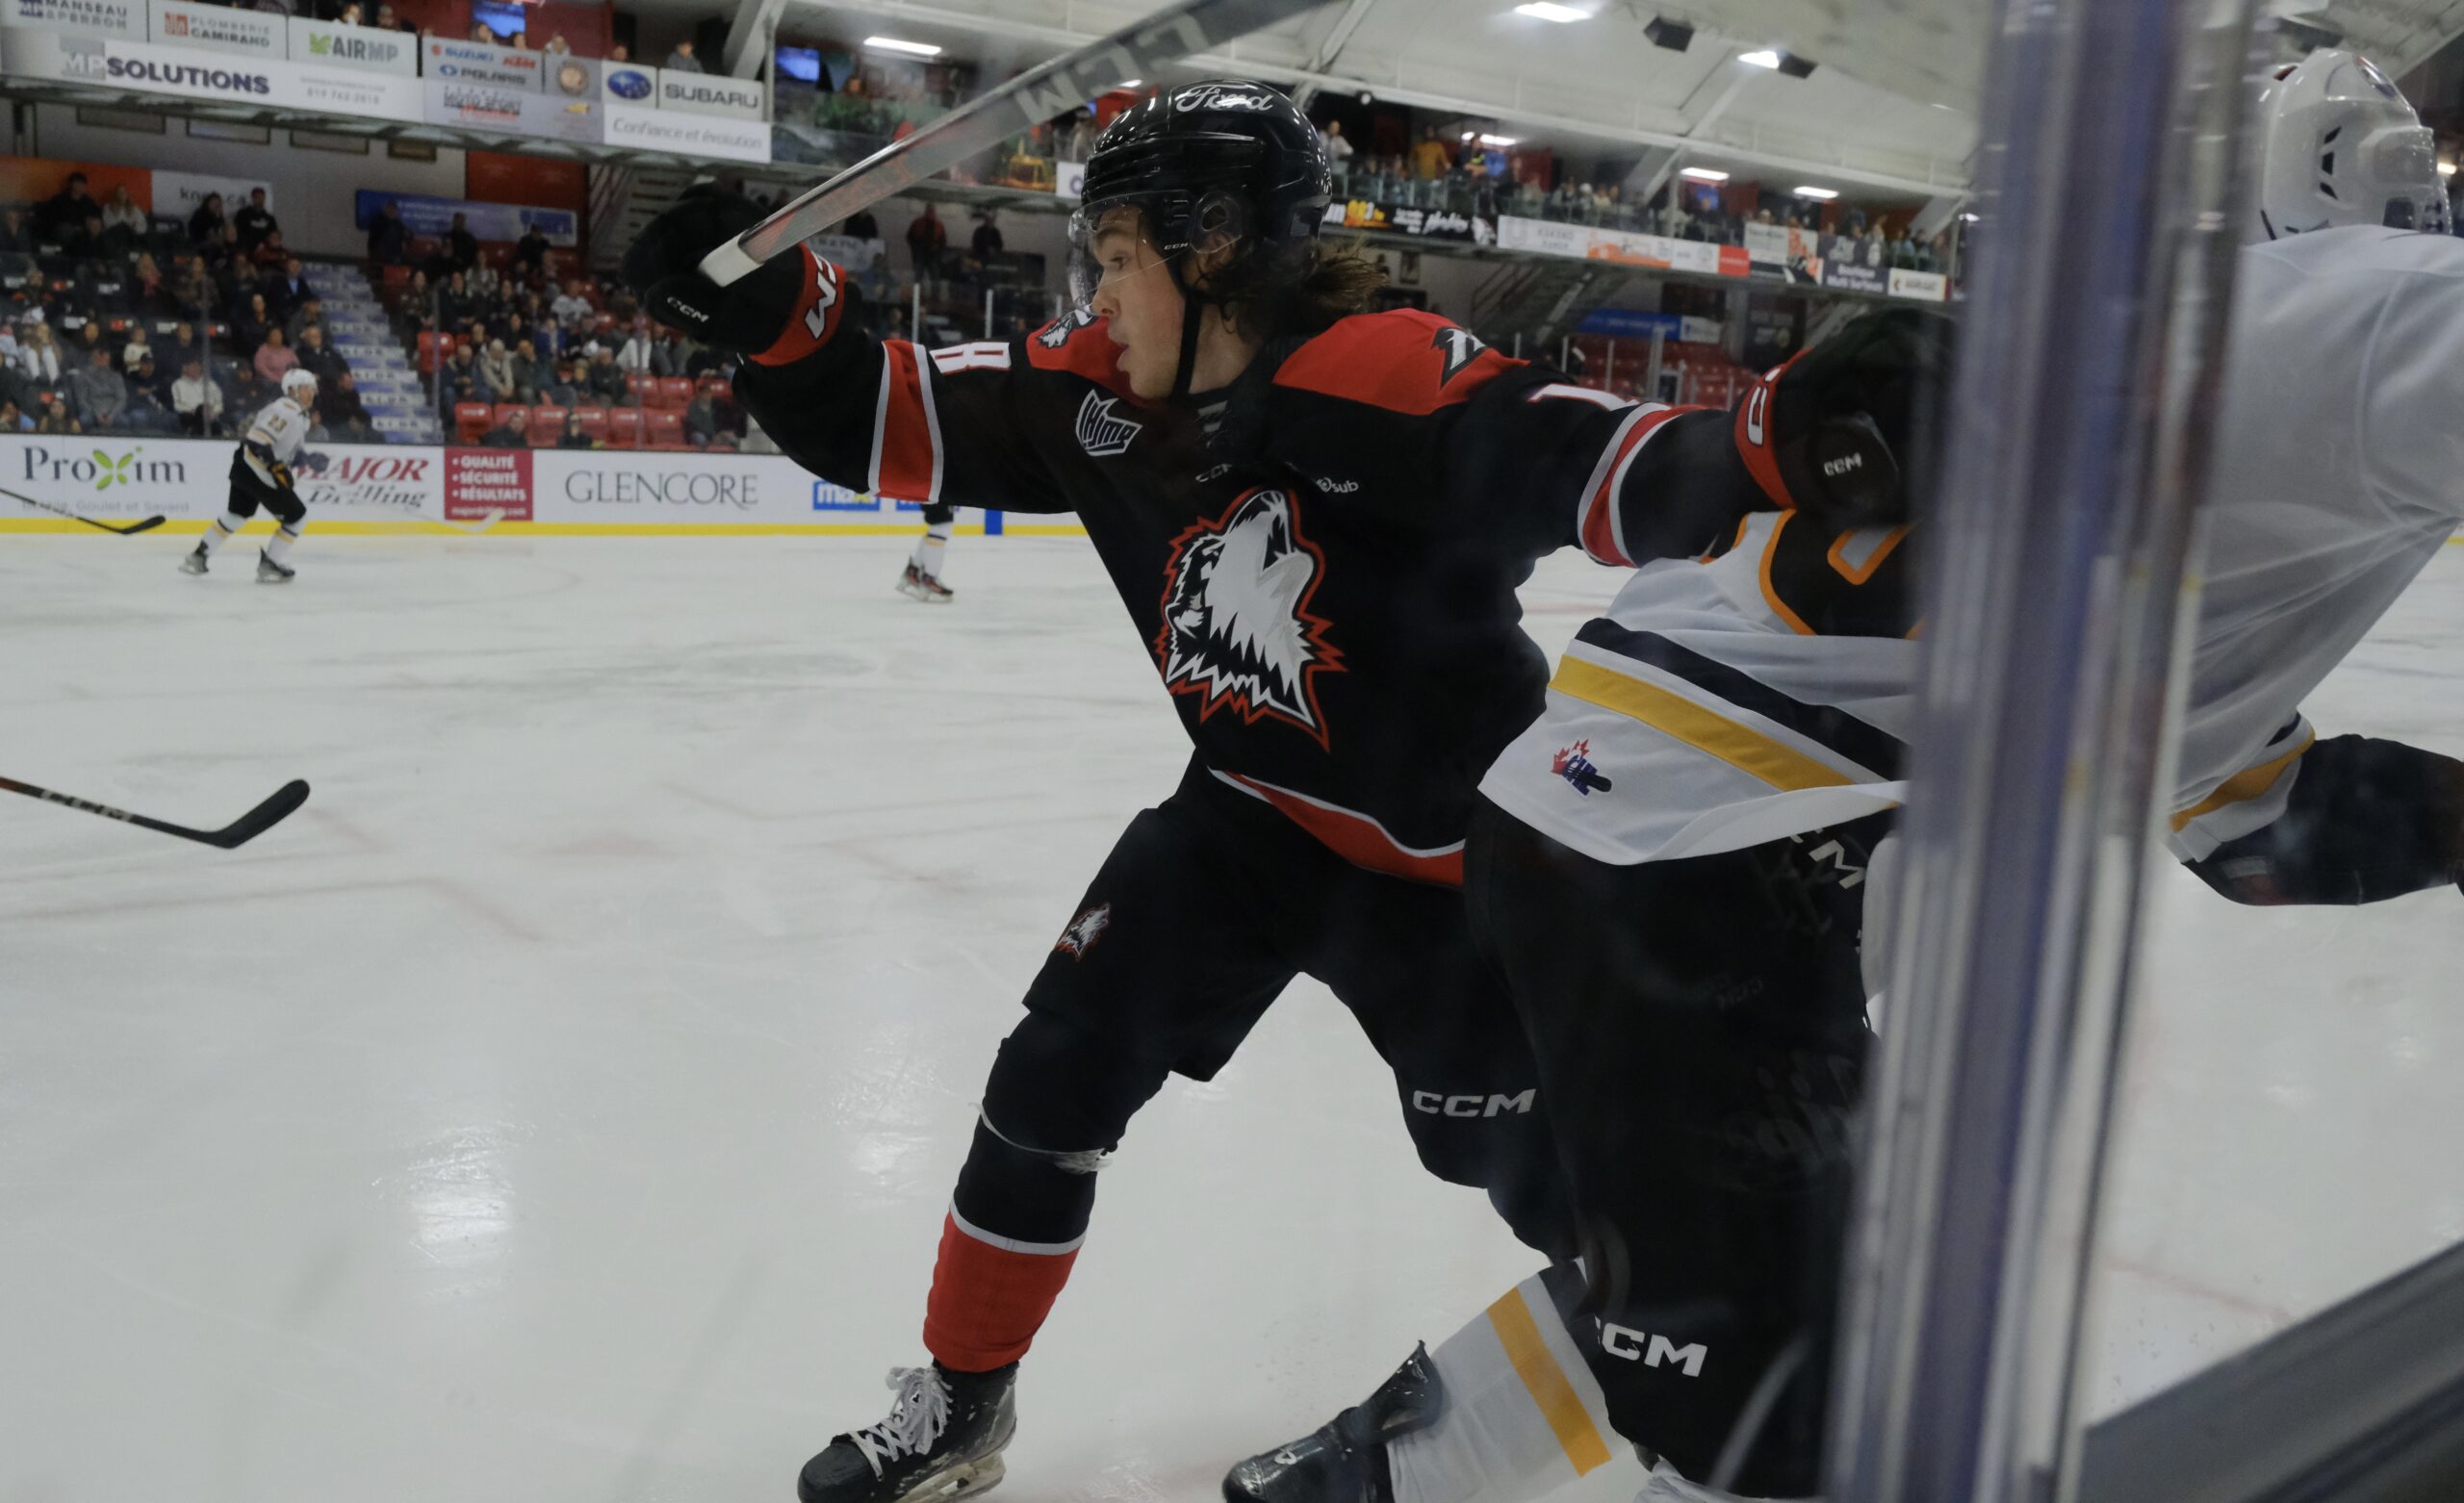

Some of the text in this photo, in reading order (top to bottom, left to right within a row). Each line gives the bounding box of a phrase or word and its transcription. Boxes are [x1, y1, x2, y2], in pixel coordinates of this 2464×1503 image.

[107, 56, 270, 94] SOLUTIONS
[460, 66, 526, 86] POLARIS
[665, 83, 758, 109] SUBARU
[1174, 84, 1274, 113] Ford
[613, 116, 683, 140] Confiance
[684, 128, 700, 141] et
[702, 129, 763, 150] évolution
[1164, 242, 1189, 250] CCM
[23, 445, 187, 491] Proxim
[461, 453, 516, 470] QUALITÉ
[1823, 452, 1863, 476] CCM
[460, 469, 519, 485] SÉCURITÉ
[564, 469, 758, 511] GLENCORE
[460, 485, 526, 502] RÉSULTATS
[1412, 1088, 1537, 1118] CCM
[1594, 1314, 1708, 1378] CM
